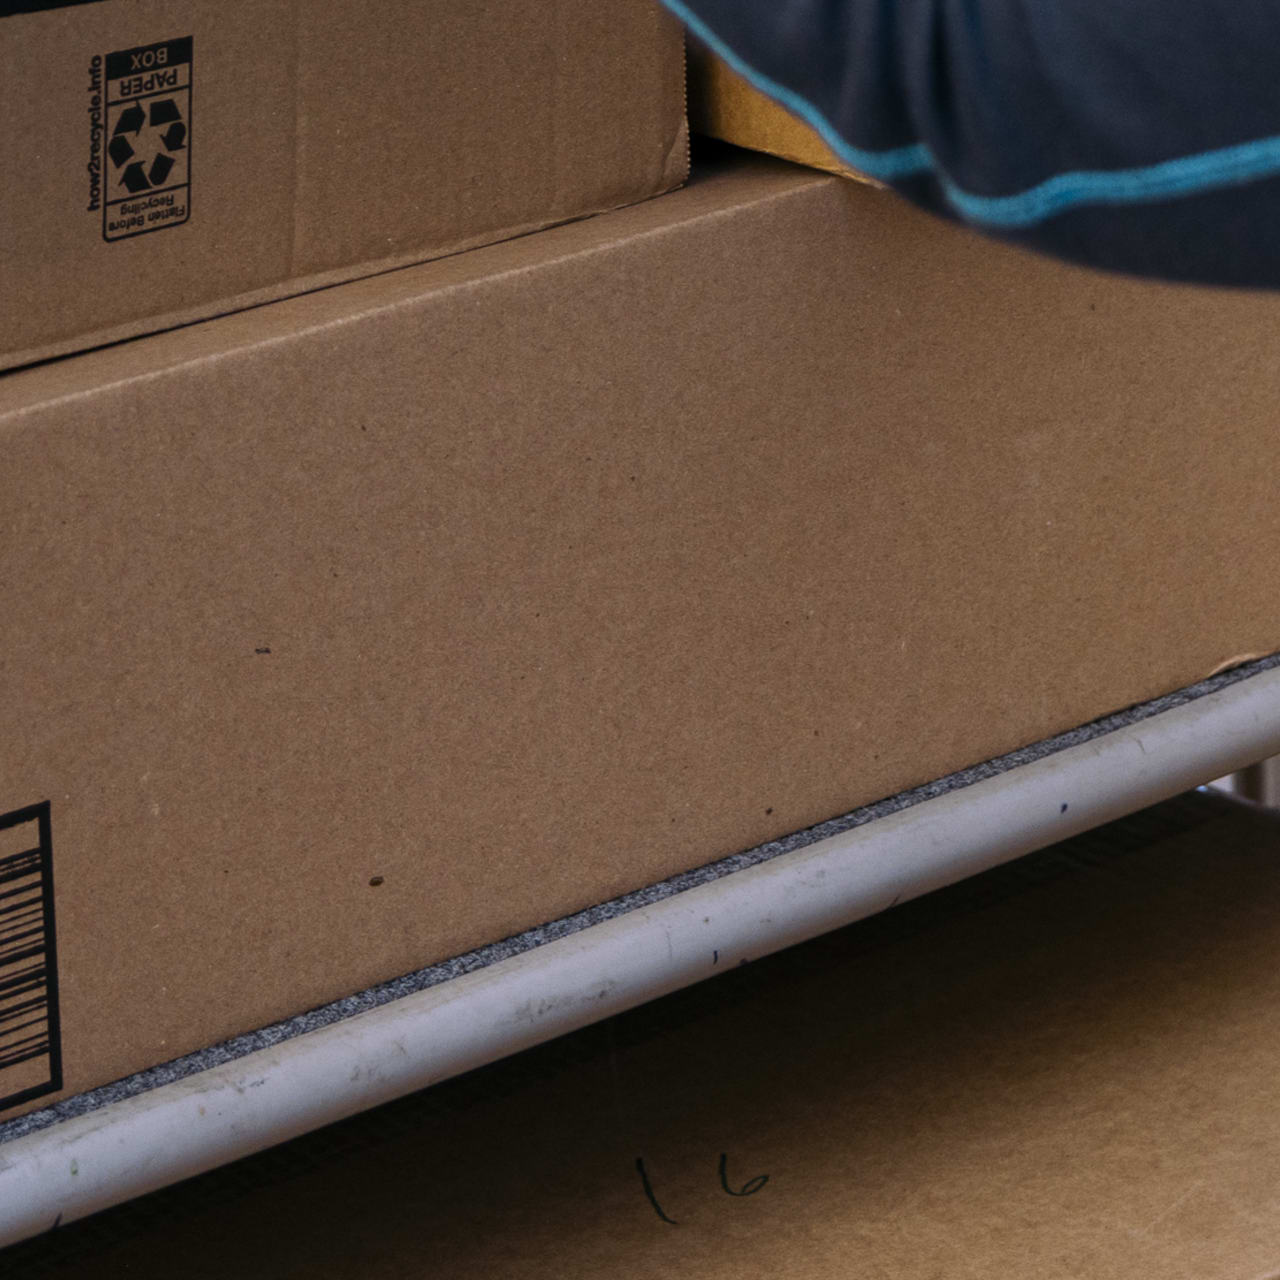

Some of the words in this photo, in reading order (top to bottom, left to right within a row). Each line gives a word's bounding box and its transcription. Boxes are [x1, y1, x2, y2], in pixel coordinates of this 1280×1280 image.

[130, 46, 169, 71] BOX
[119, 67, 179, 97] PAPER
[87, 54, 103, 212] how2recycle.info
[120, 194, 175, 216] Recycling
[147, 204, 186, 223] Flatten
[108, 215, 145, 233] Before
